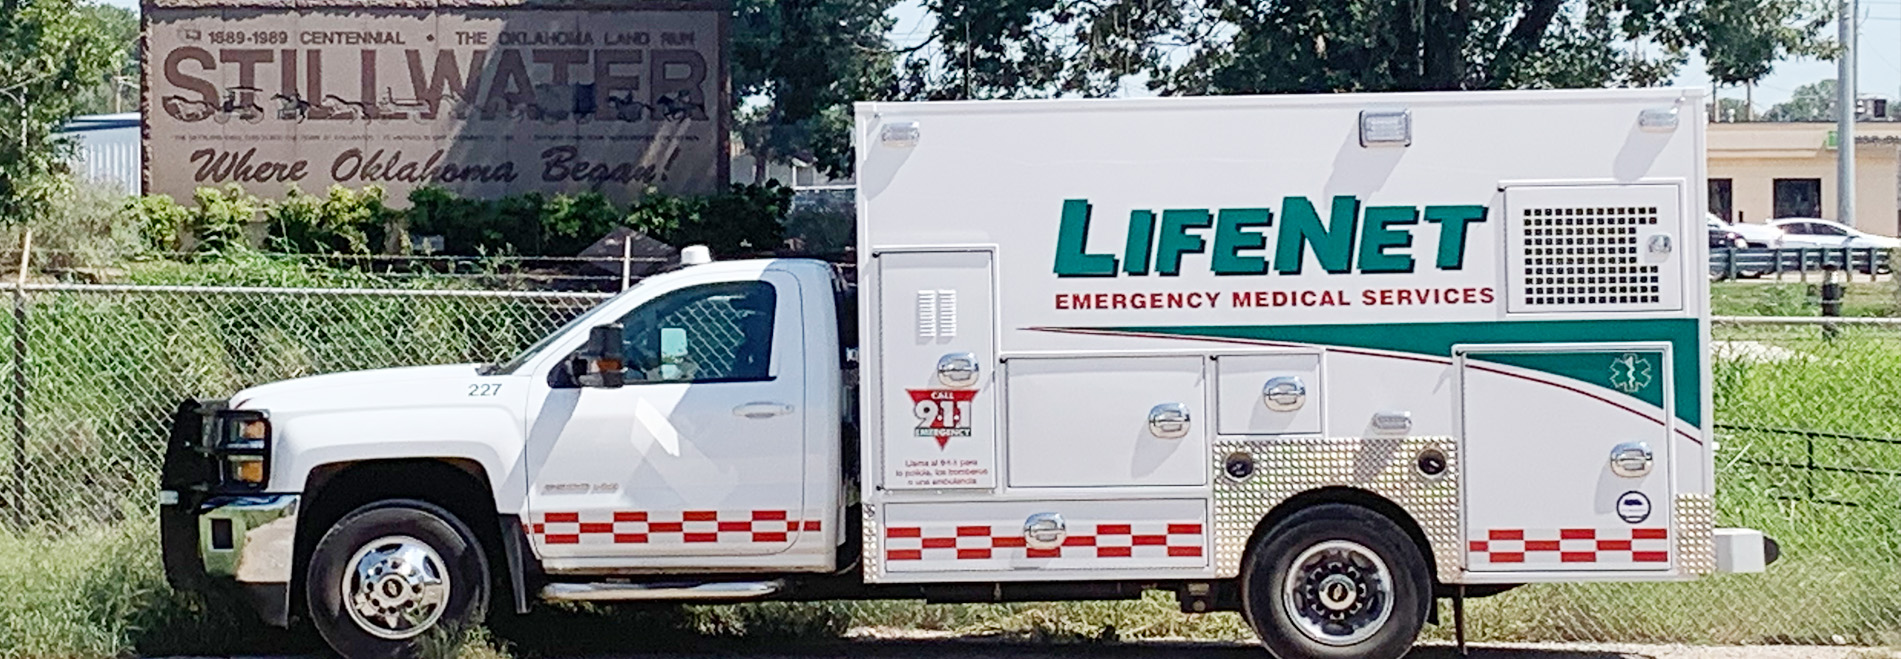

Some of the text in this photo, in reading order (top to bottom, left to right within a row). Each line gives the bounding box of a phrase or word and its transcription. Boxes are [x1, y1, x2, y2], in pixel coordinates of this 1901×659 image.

[208, 31, 696, 46] 1889-1989 CENTENNIAL THE OKLAHOMA LAND RUN
[162, 46, 710, 122] STILLWATER
[190, 145, 679, 191] Where Oklahoma Began!
[1055, 287, 1496, 310] EMERGENCY MEDICAL SERVICES
[468, 384, 502, 397] 227
[930, 391, 955, 400] CALL
[914, 428, 972, 437] EMERGENCY
